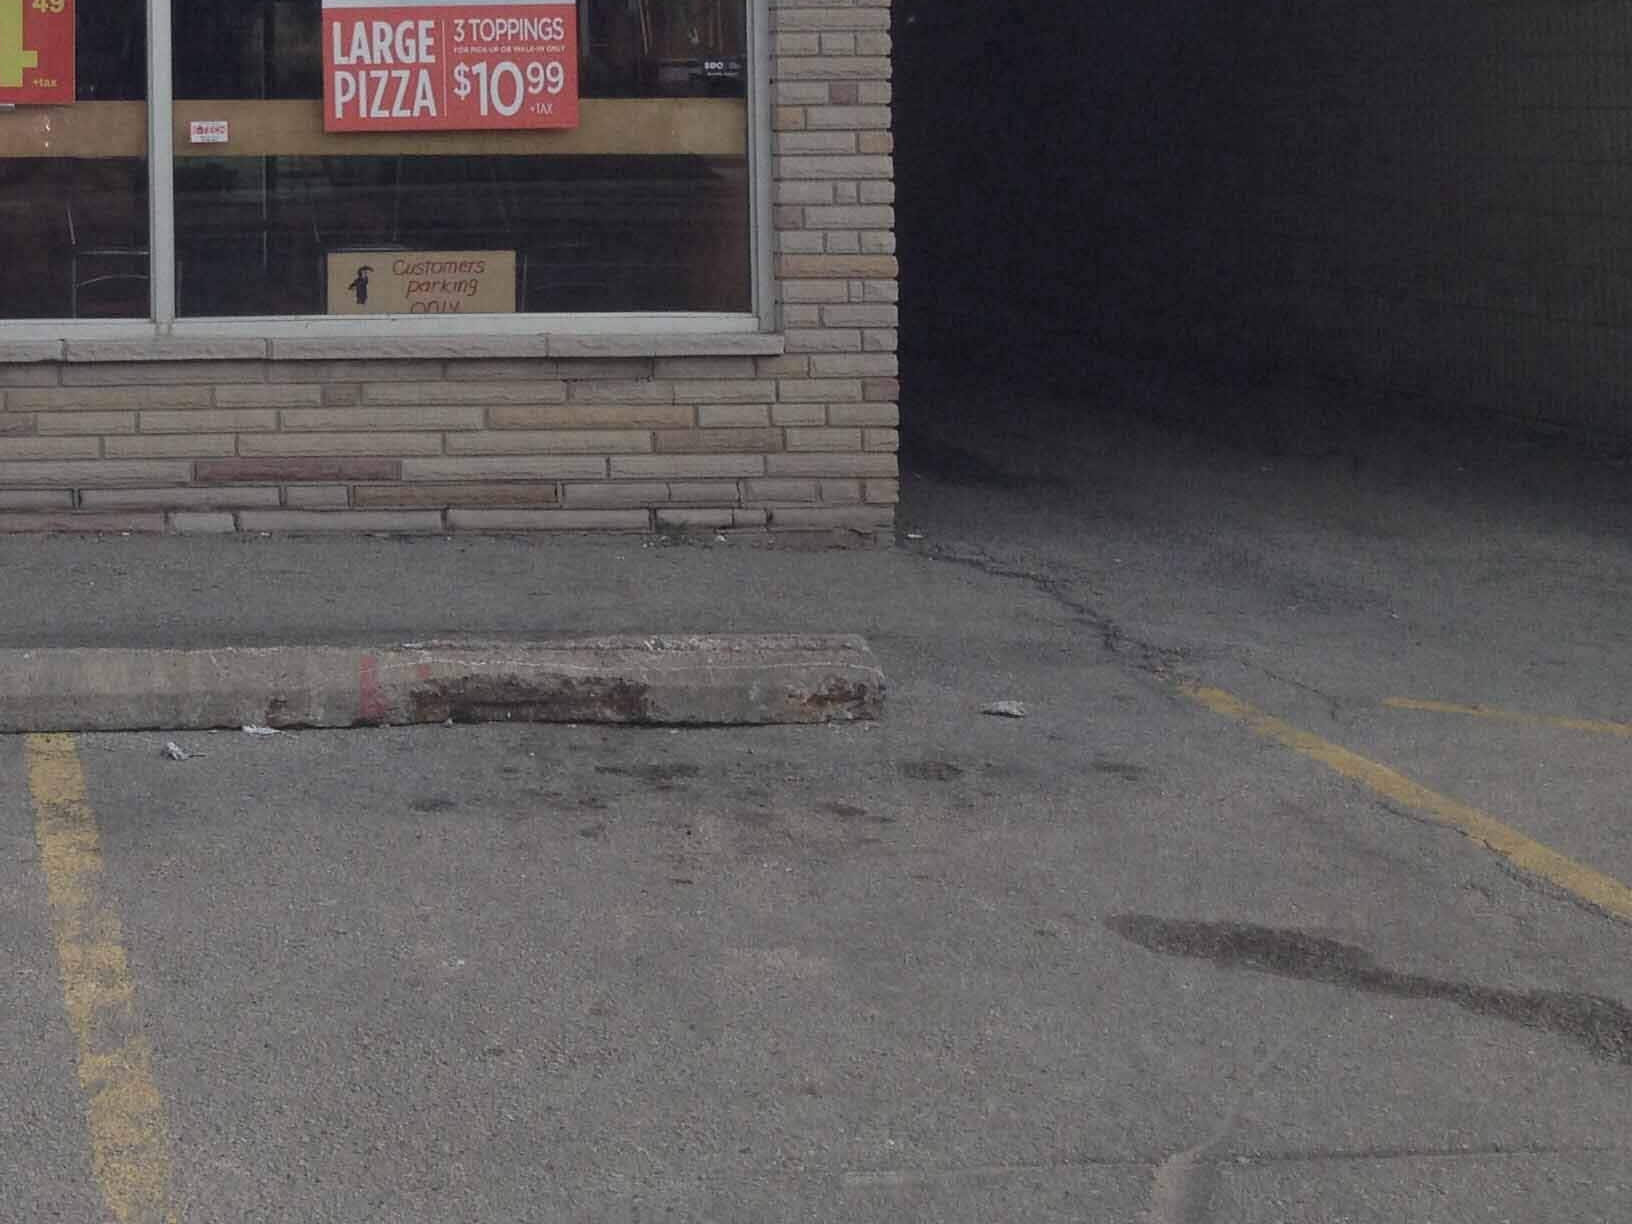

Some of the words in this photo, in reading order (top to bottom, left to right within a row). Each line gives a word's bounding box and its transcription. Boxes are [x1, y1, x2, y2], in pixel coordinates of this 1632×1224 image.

[332, 19, 436, 65] LARGE
[453, 19, 465, 42] 3
[467, 17, 565, 41] TOPPINGS
[334, 68, 437, 119] PIZZA
[392, 259, 486, 276] Customers
[405, 278, 479, 298] parking
